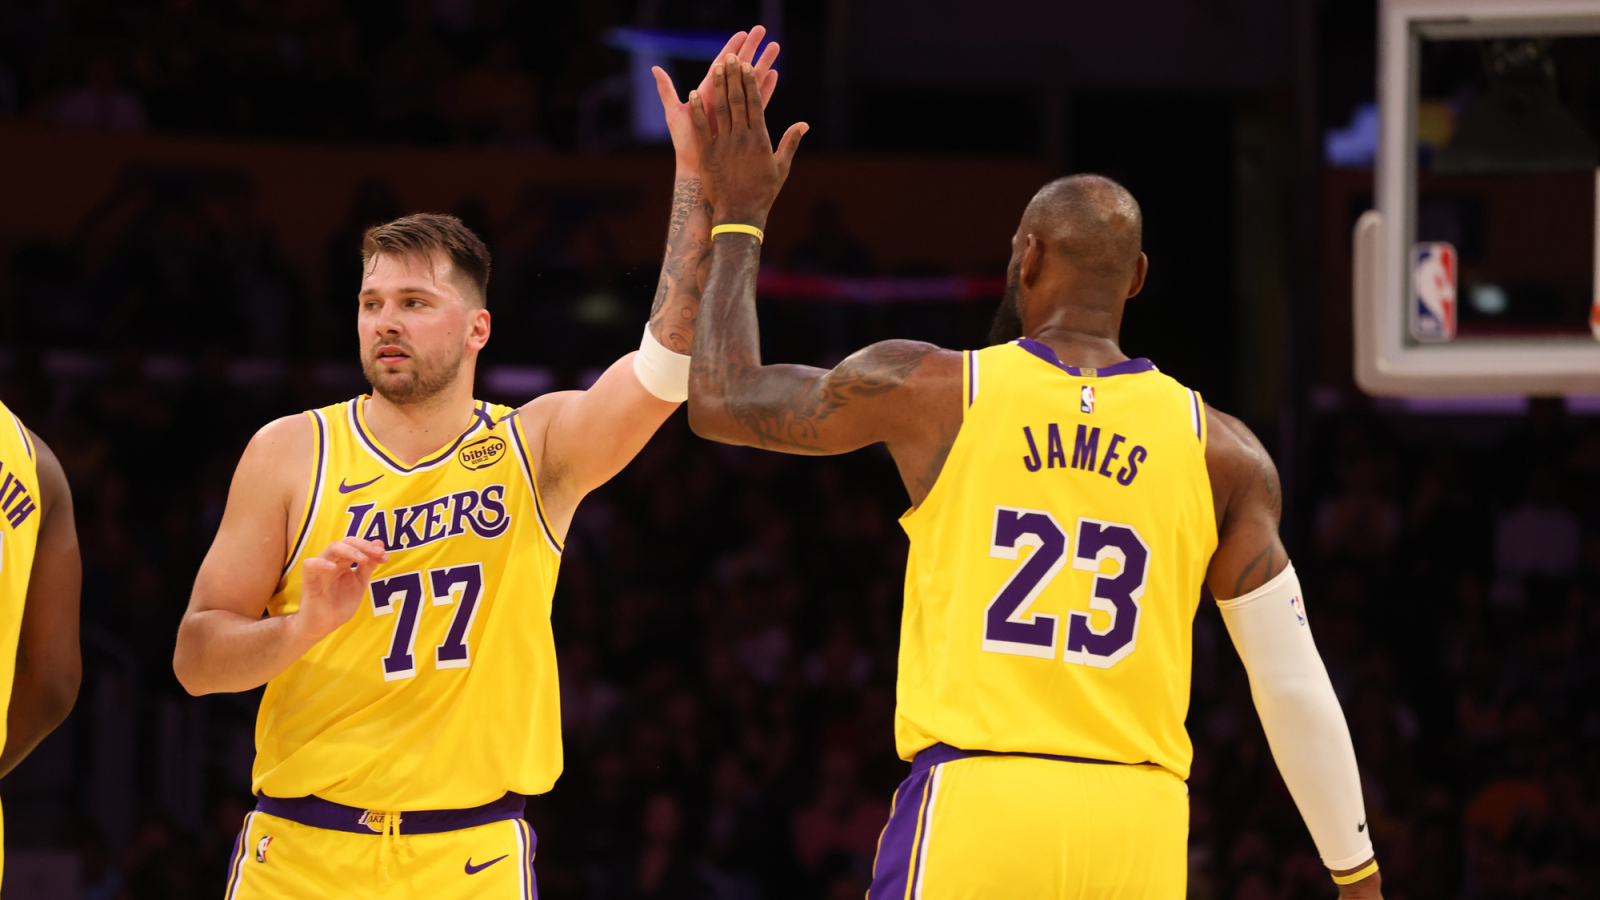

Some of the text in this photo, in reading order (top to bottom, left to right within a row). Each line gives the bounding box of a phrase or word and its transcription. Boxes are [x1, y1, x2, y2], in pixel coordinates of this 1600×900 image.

[462, 442, 504, 462] bibigo
[1023, 423, 1148, 487] JAMES
[0, 461, 37, 530] ITH
[981, 504, 1152, 669] 23
[368, 562, 485, 683] 77
